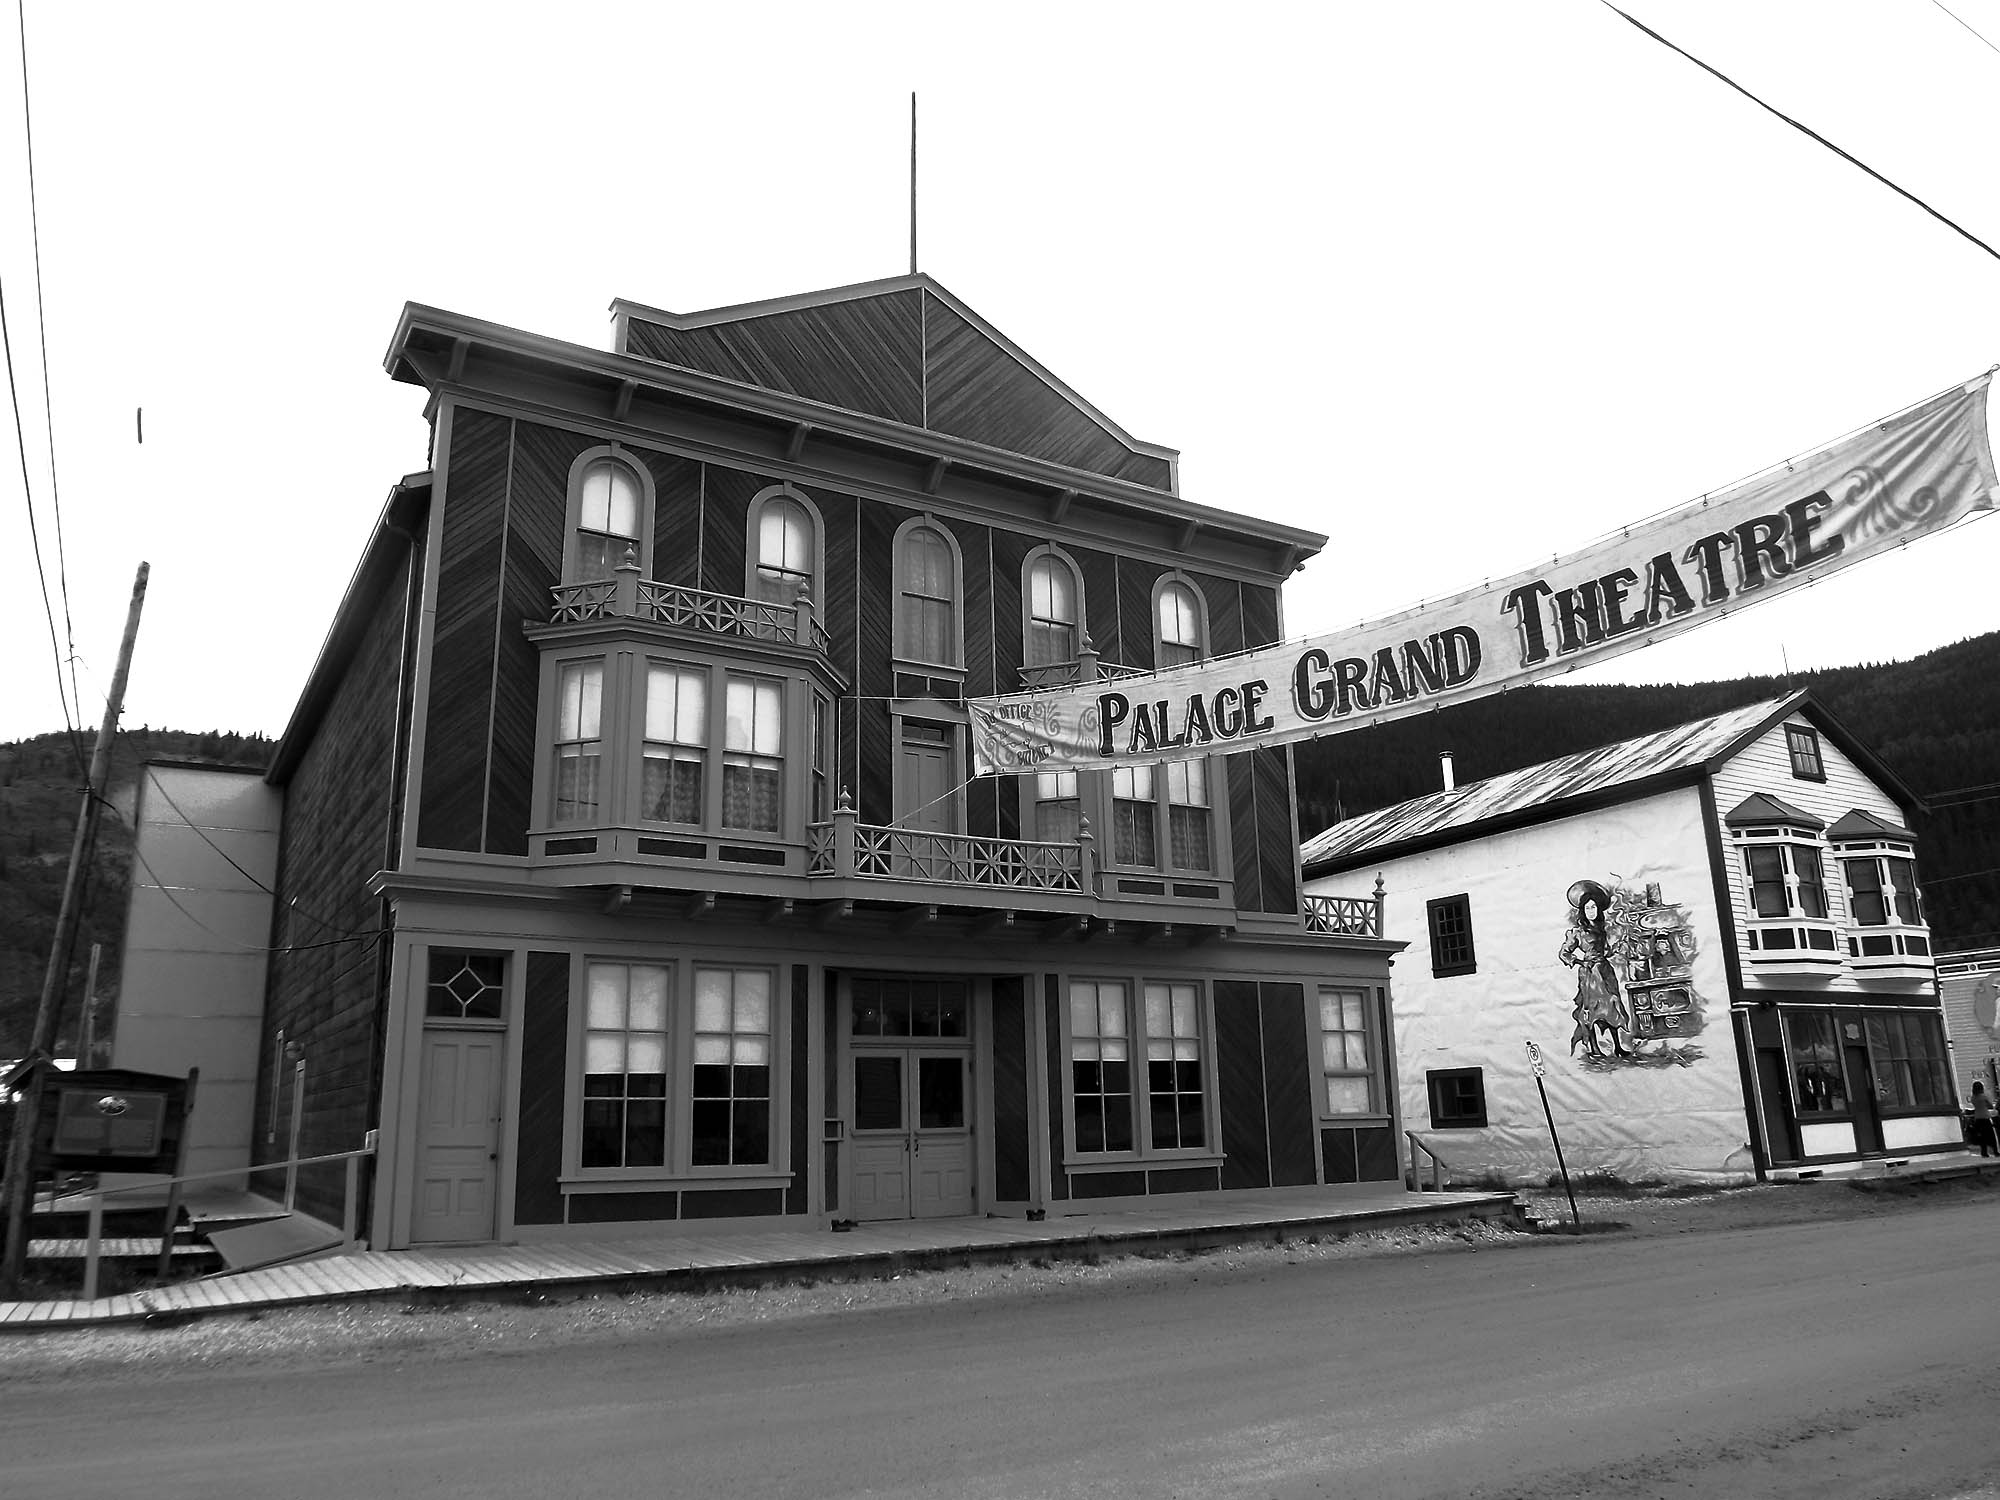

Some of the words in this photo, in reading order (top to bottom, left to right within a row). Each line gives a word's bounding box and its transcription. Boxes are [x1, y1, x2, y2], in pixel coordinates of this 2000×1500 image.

[1096, 679, 1274, 758] PALACE
[1289, 625, 1482, 722] GRAND
[1500, 489, 1845, 668] THEATRE
